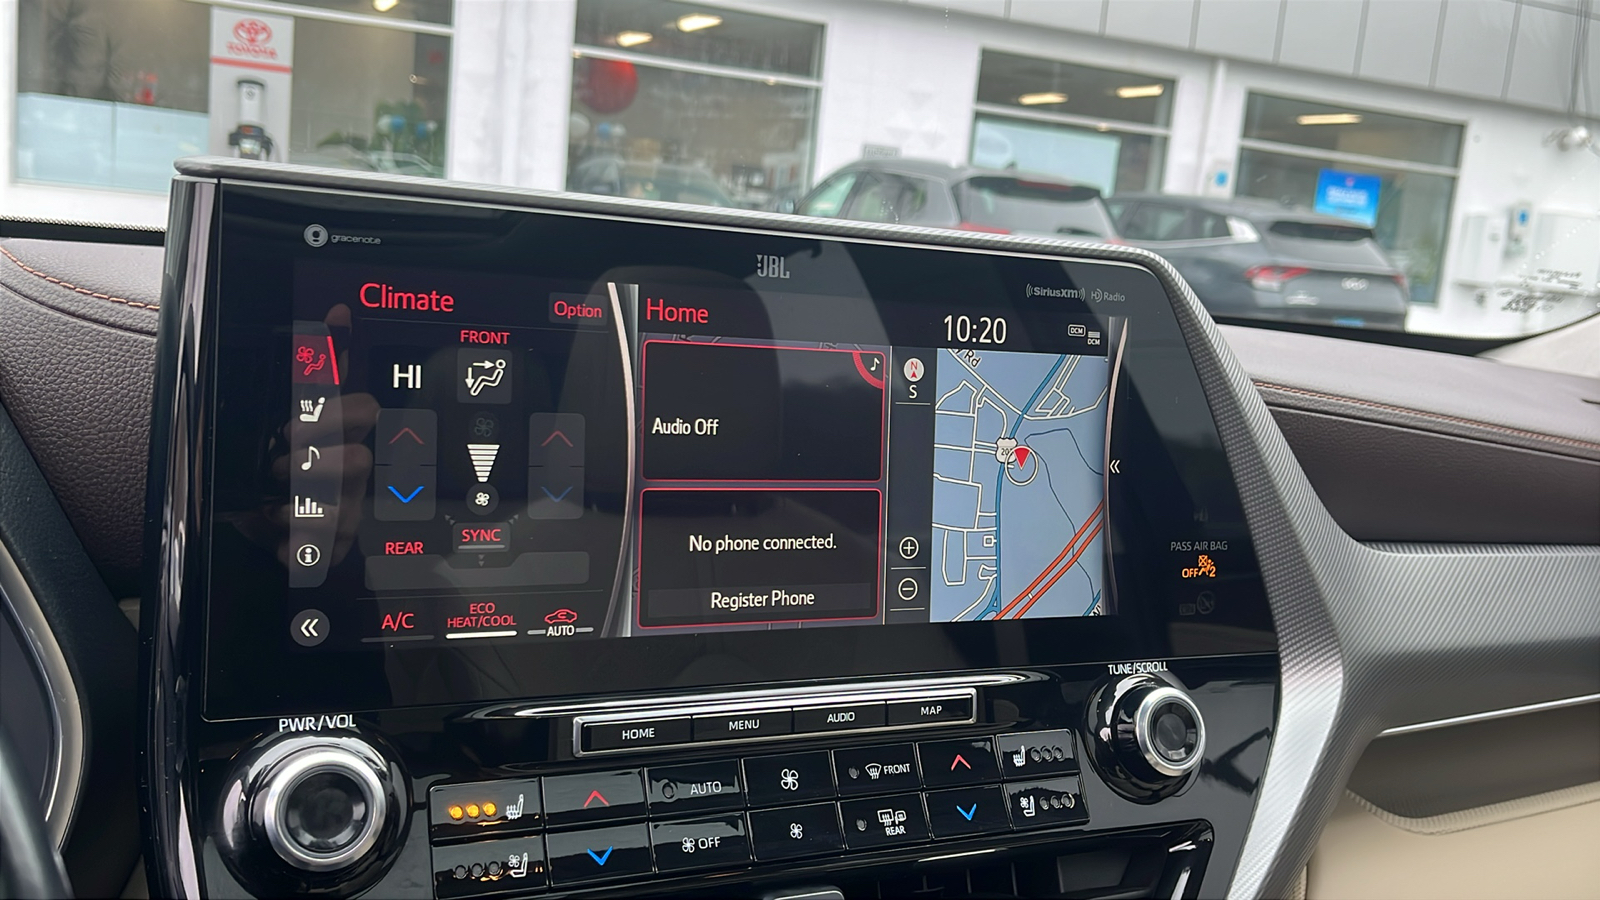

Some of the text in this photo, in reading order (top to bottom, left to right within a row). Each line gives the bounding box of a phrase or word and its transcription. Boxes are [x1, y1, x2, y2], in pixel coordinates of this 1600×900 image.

[331, 234, 381, 245] gracenote
[756, 254, 790, 279] JBL
[359, 282, 454, 312] Climate
[1103, 291, 1126, 302] Radio
[553, 300, 602, 318] Option
[646, 298, 709, 323] Home
[943, 314, 1007, 344] 10:20
[460, 330, 511, 345] FRONT
[1087, 338, 1101, 346] DCM
[964, 349, 981, 368] Rd
[392, 364, 422, 389] HI
[908, 385, 918, 399] S
[651, 417, 719, 436] Audio Off
[462, 529, 501, 542] SYNC
[385, 542, 424, 555] REAR
[689, 533, 837, 555] No phone connected.
[1170, 541, 1228, 551] PASS AIR BAG
[1181, 568, 1199, 578] OFF
[710, 590, 815, 611] Register Phone
[469, 602, 496, 615] ECO
[381, 612, 414, 631] A/C
[447, 614, 517, 628] HEAT/COOL
[546, 624, 575, 637] AUTO
[1107, 661, 1168, 675] TUNE/SCROLL
[826, 711, 856, 724] AUDIO
[920, 705, 943, 716] MAP
[279, 714, 357, 733] PWR/VOL
[728, 719, 760, 731] MENU
[622, 727, 655, 740] HOME
[883, 763, 911, 774] FRONT
[690, 781, 722, 795] AUTO
[885, 825, 906, 836] REAR
[698, 837, 721, 849] OFF
